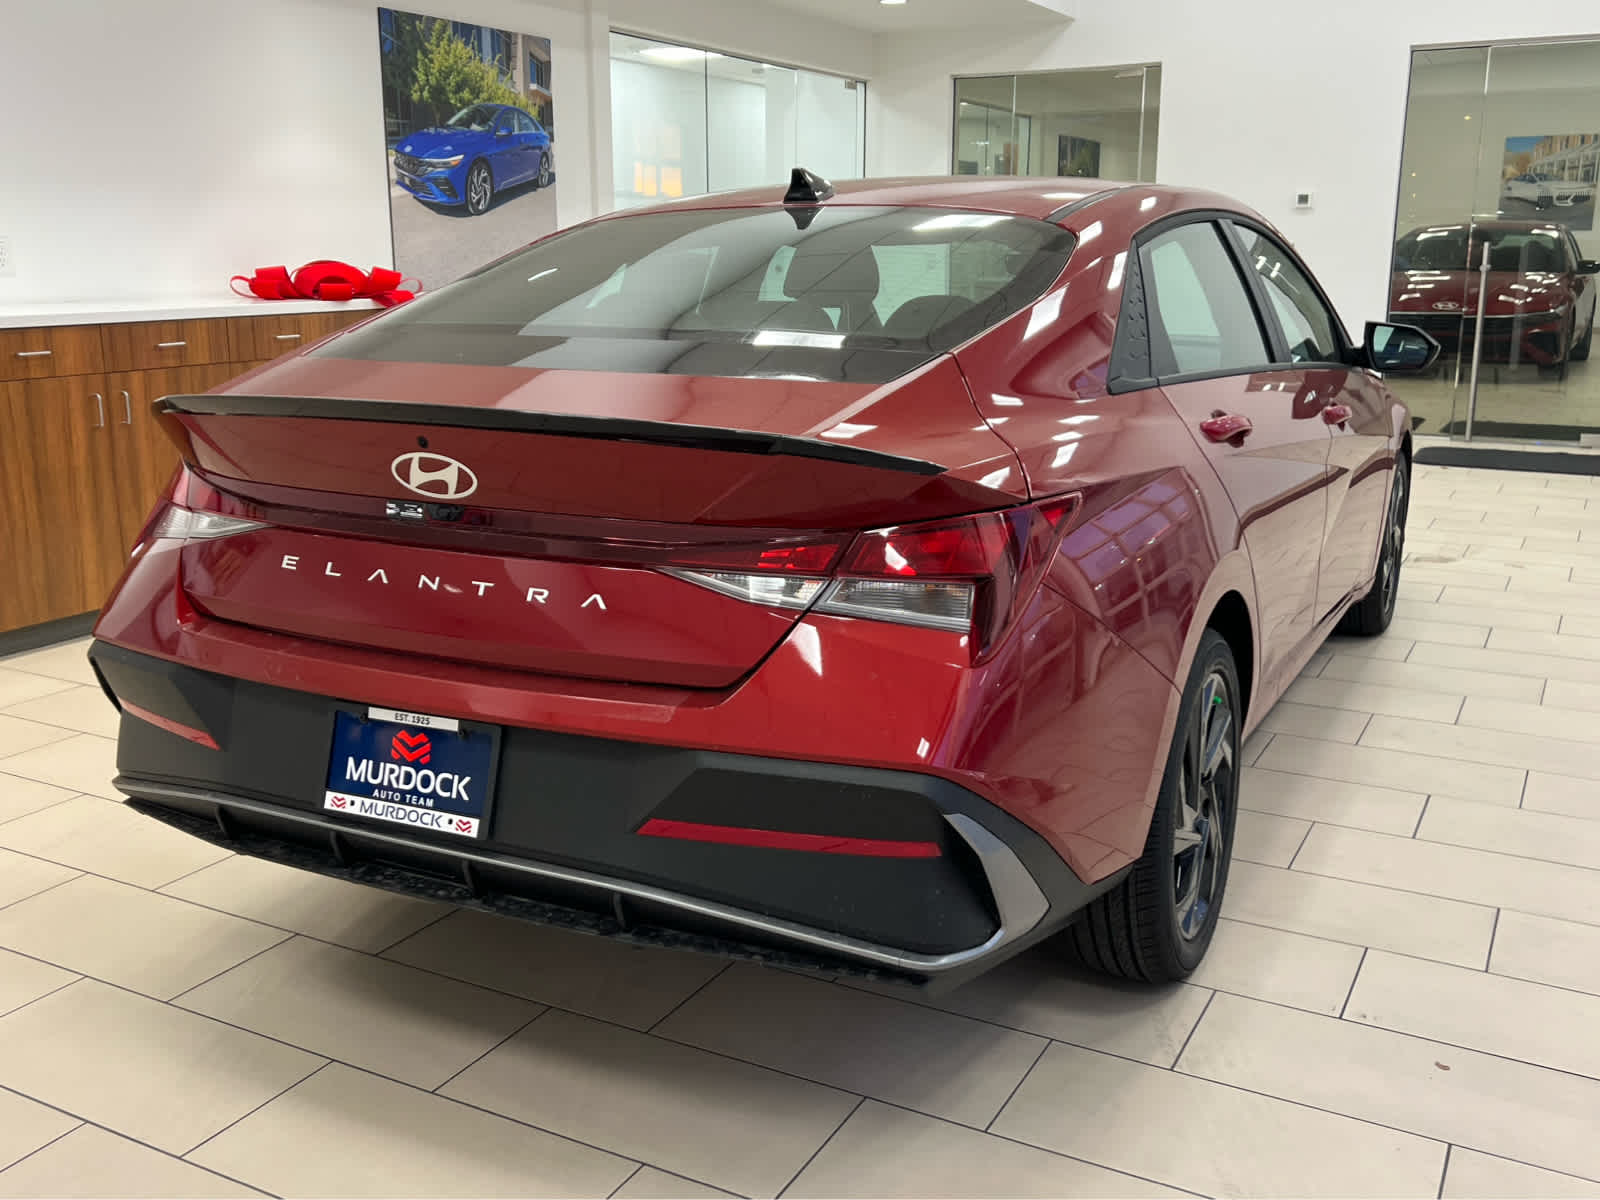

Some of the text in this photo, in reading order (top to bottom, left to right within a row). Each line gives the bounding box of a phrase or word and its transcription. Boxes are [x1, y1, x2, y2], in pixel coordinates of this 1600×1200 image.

[281, 554, 607, 610] ELANTRA
[394, 713, 431, 726] EST. 1925
[345, 756, 472, 801] MURDOCK
[372, 789, 434, 808] AUTO TEAM
[359, 800, 443, 828] MURDOCK
